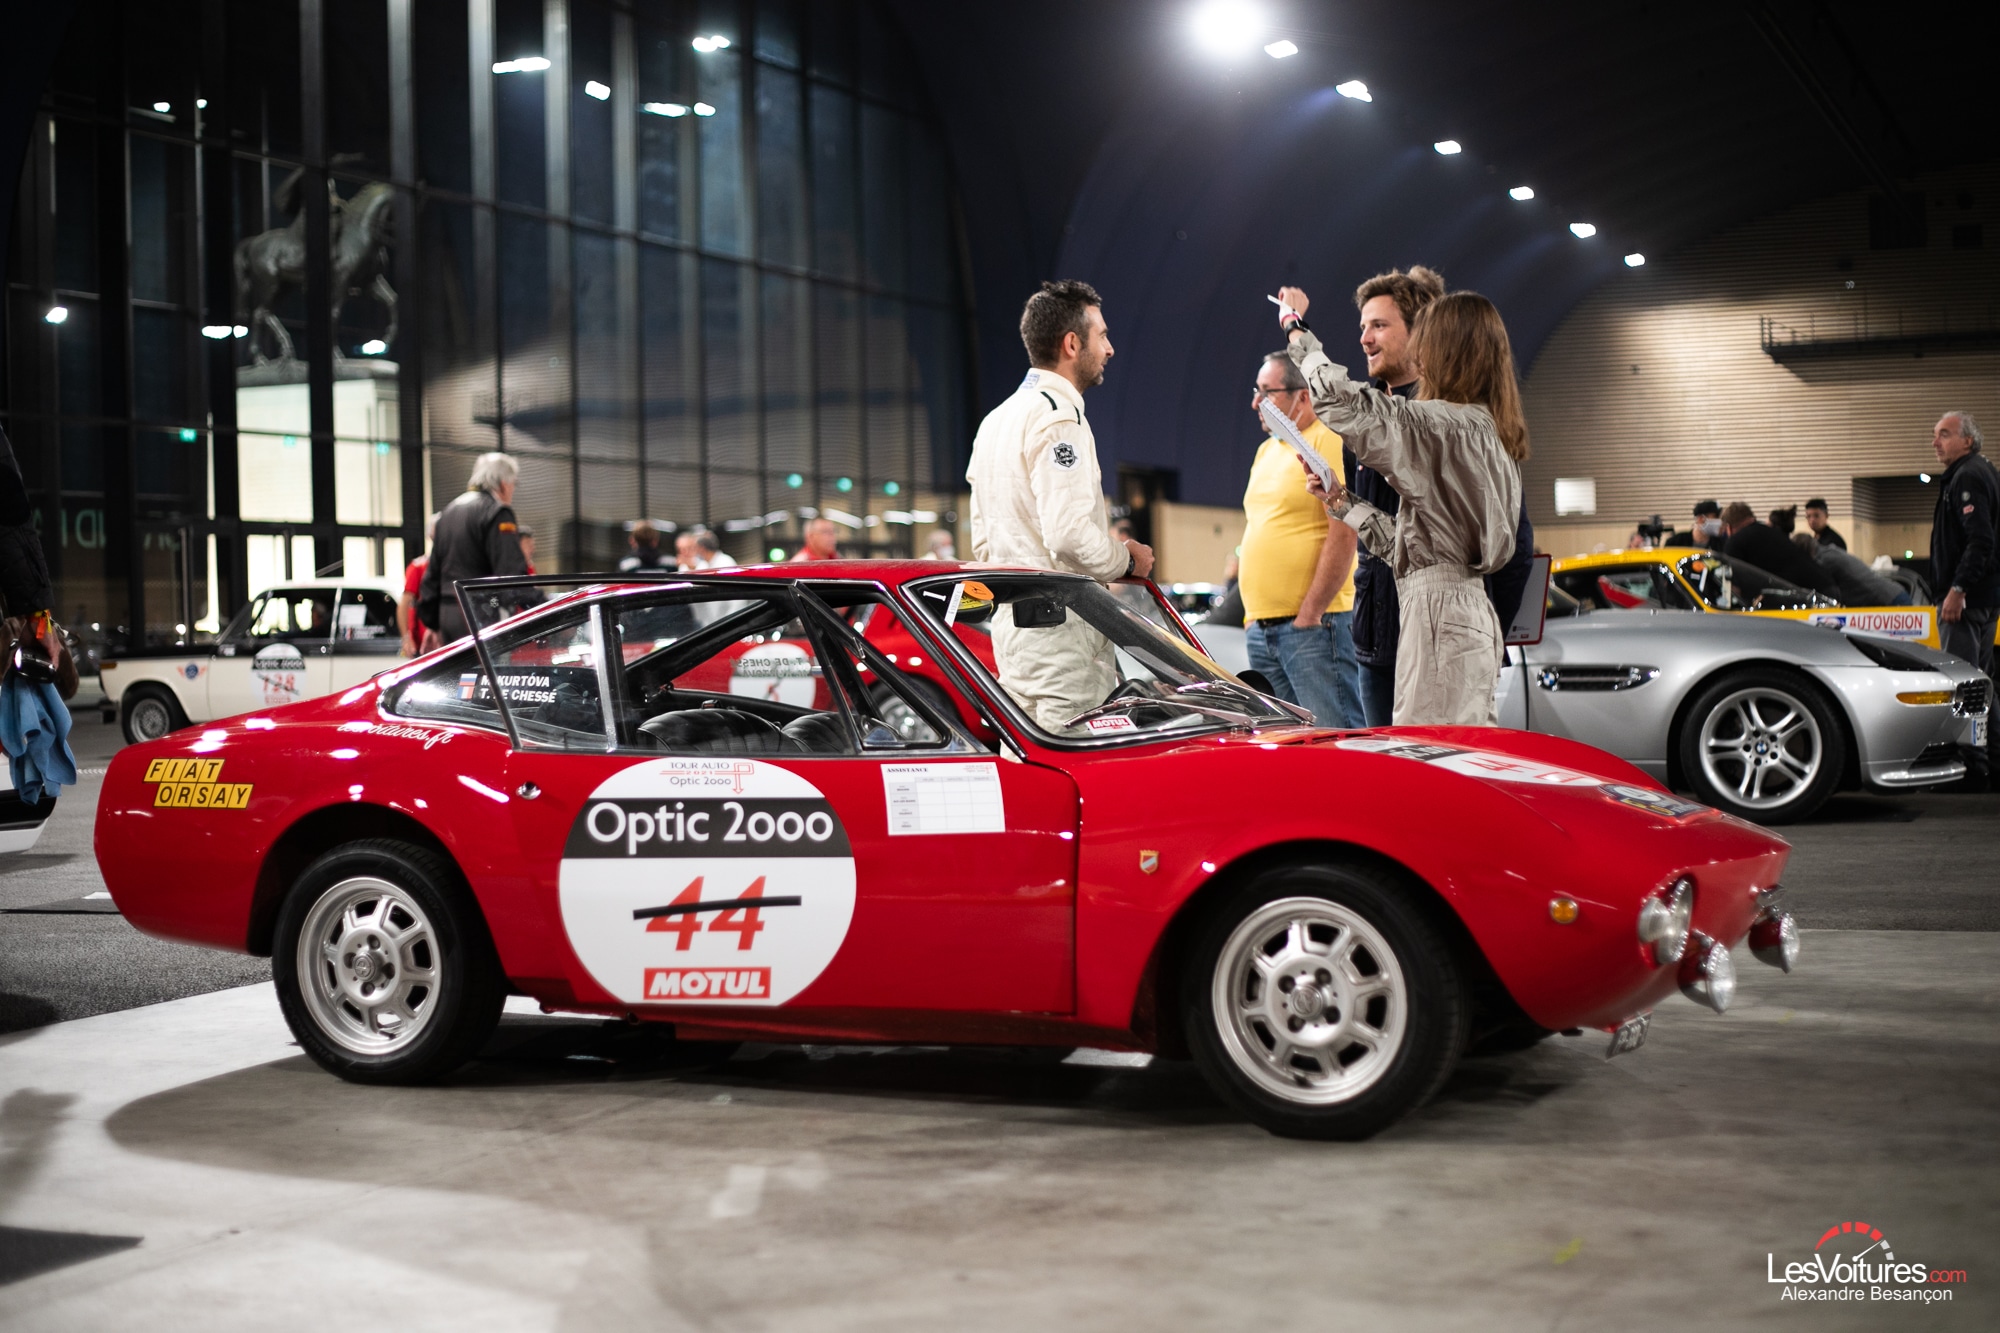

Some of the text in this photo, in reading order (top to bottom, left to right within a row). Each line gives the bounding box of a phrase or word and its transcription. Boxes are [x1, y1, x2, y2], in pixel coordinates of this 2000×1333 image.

[1850, 614, 1923, 630] AUTOVISION
[480, 689, 557, 703] T. E CHESSÉ
[1093, 718, 1128, 728] MOTUL
[150, 762, 219, 779] FIAT
[670, 776, 731, 788] Optic 2000
[159, 786, 248, 804] ORSAY
[587, 801, 834, 856] Optic 2000
[645, 875, 767, 951] 44
[649, 971, 766, 996] MOTUL
